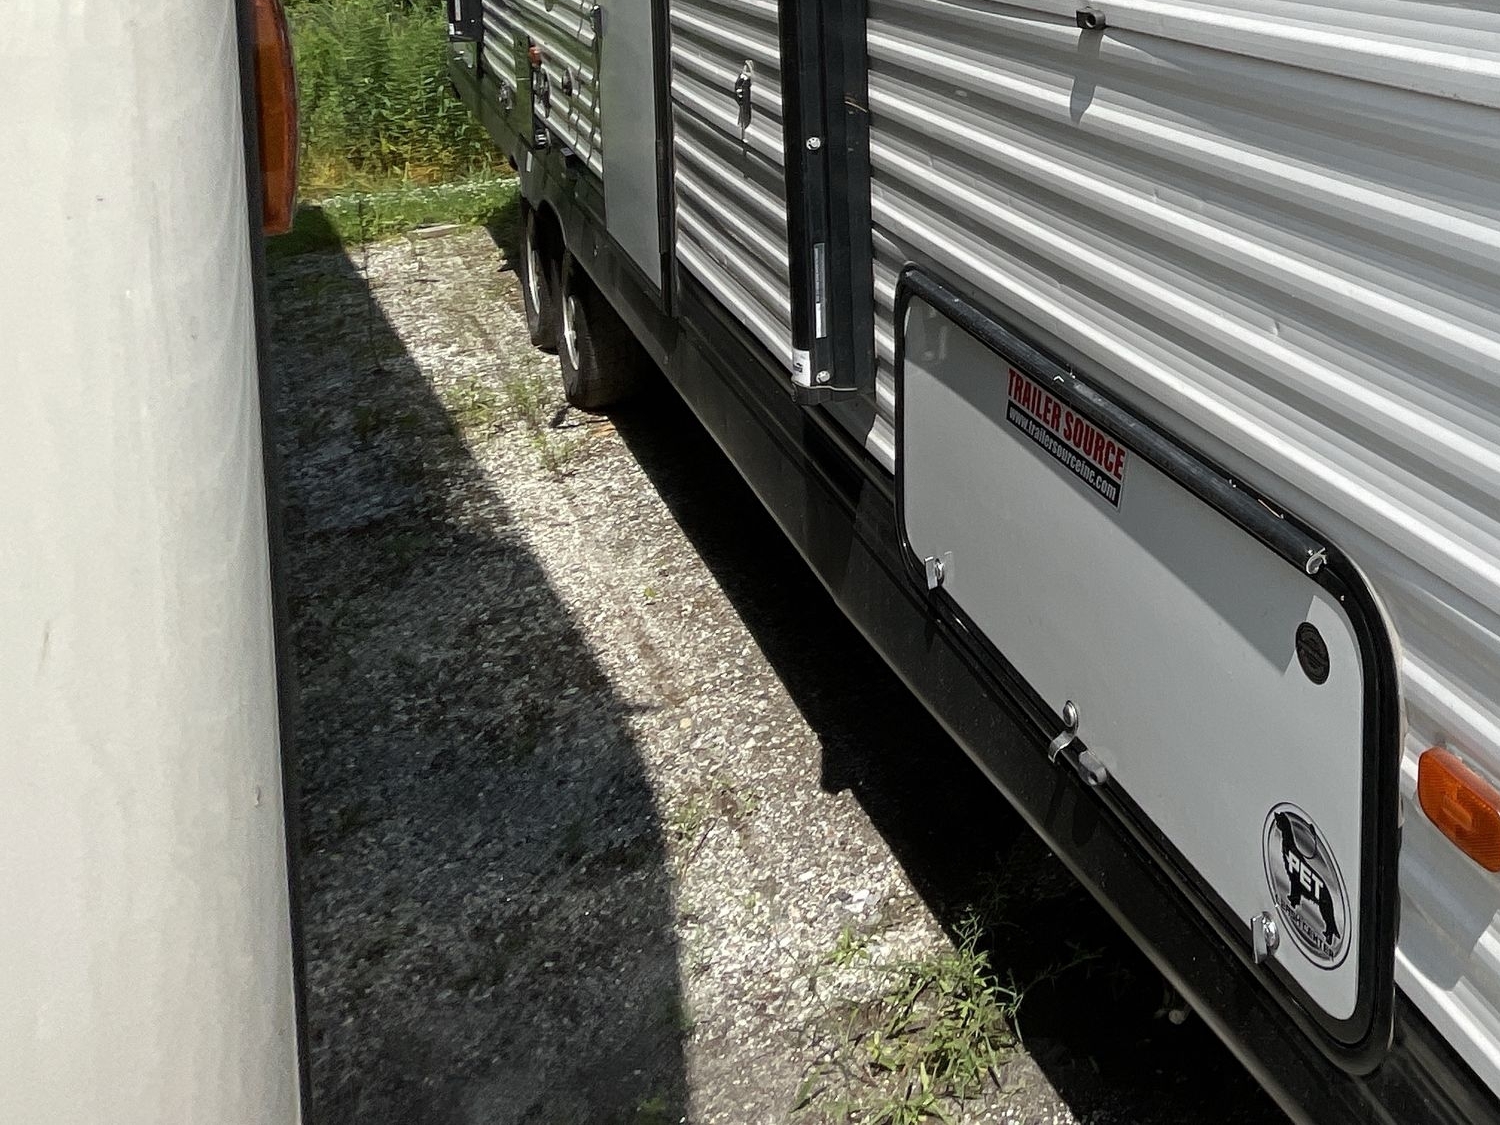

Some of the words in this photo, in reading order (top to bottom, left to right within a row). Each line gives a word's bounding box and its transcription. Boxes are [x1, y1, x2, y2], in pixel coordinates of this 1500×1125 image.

[1008, 367, 1062, 432] TRAILER
[1063, 410, 1126, 481] SOURCE
[1009, 406, 1117, 501] www.trailersourceinc.com
[1286, 850, 1324, 902] PET
[1302, 922, 1335, 958] CENTER
